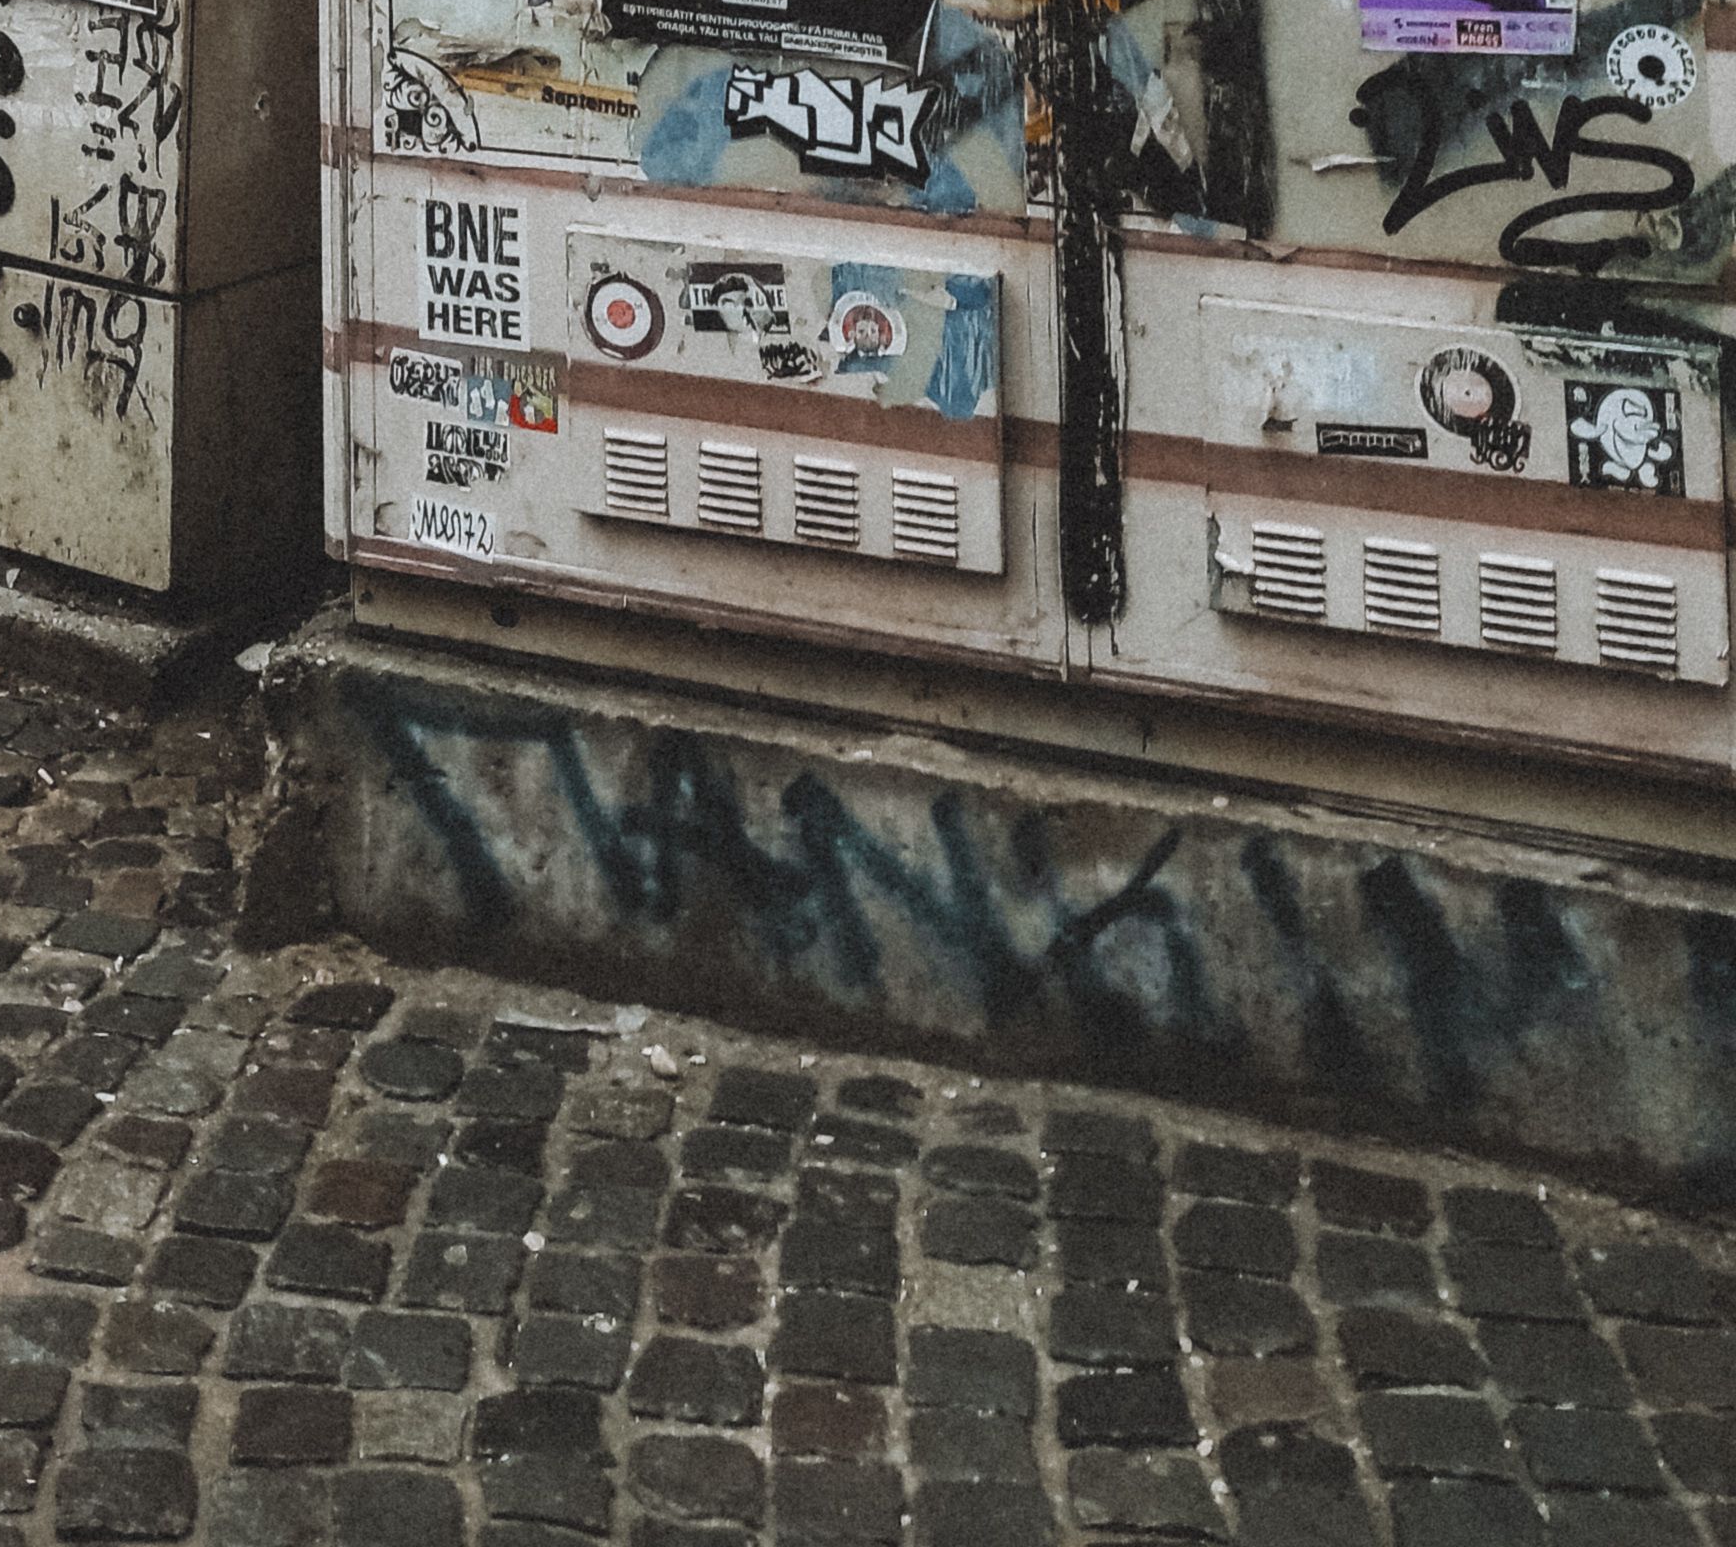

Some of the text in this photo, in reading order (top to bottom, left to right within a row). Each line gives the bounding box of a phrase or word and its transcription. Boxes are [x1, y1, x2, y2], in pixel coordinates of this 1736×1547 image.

[424, 199, 521, 268] BNE
[427, 263, 521, 304] WAS
[427, 300, 523, 343] HERE
